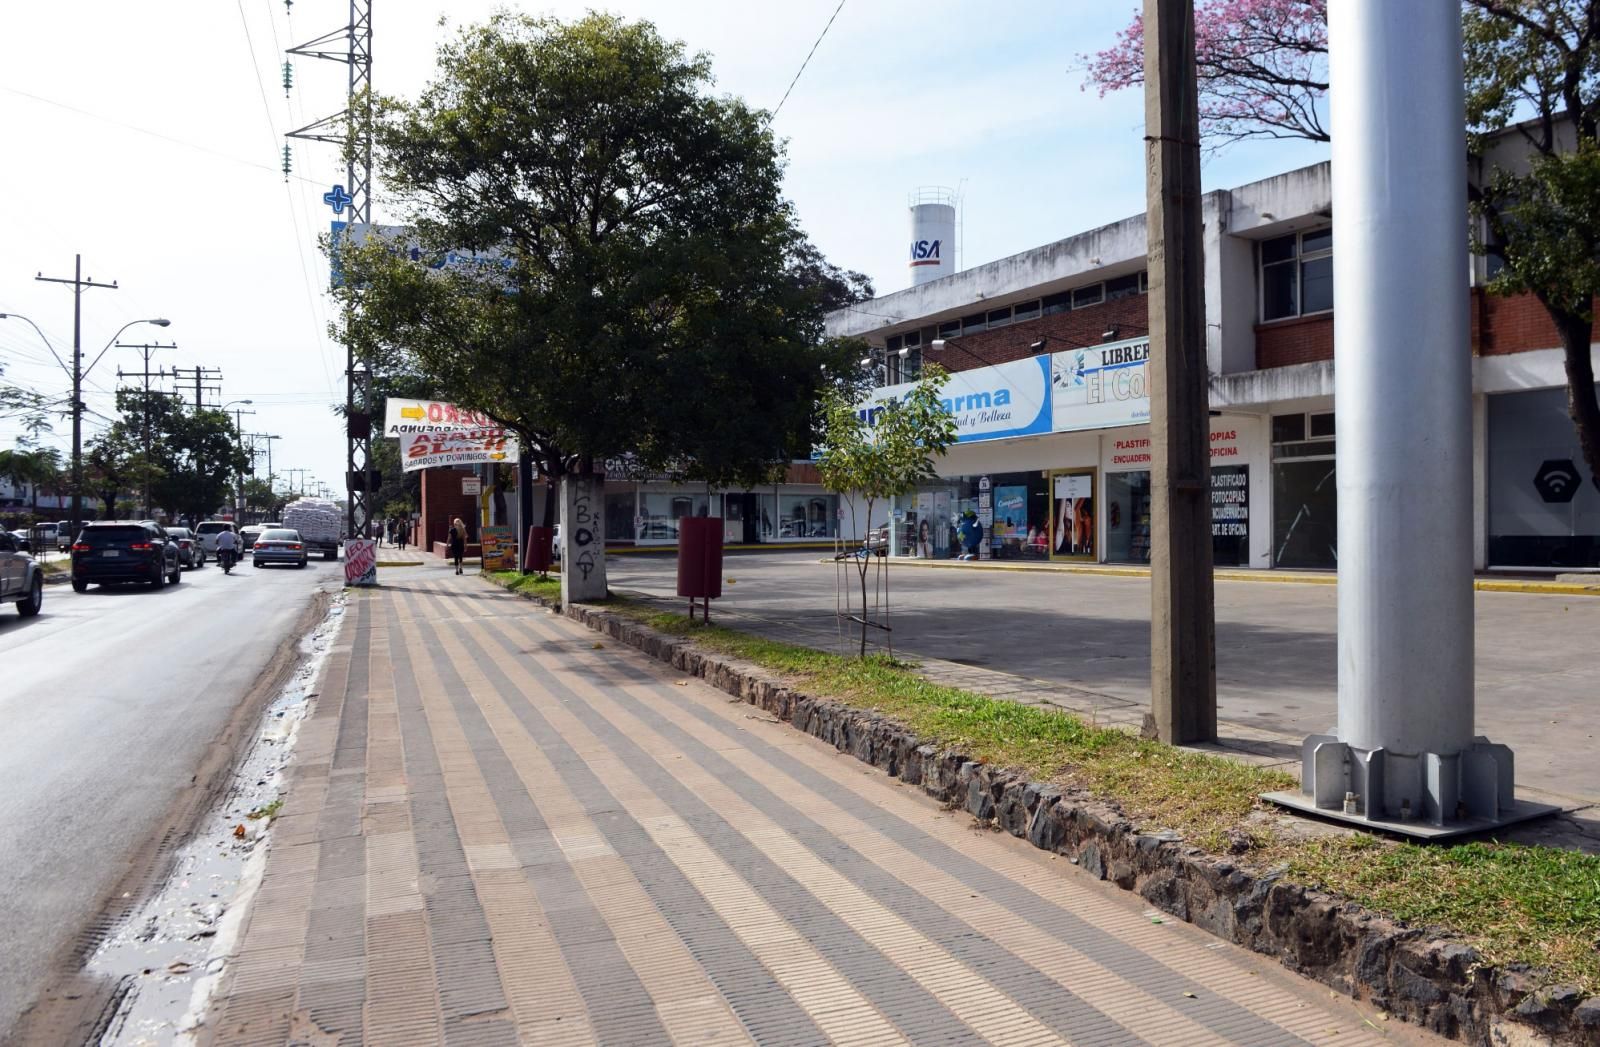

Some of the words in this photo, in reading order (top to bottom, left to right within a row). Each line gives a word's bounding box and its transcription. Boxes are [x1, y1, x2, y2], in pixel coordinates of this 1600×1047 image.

[1087, 369, 1105, 404] El
[978, 408, 1011, 423] Belleza
[1209, 431, 1236, 441] OPIAS
[1116, 439, 1150, 449] PLASTIFI
[446, 453, 487, 462] DOMINGOS
[1211, 474, 1246, 487] PLASTIFICADO
[1211, 490, 1246, 503] FOTOCOPIAS
[1212, 507, 1248, 519] NCUADERNACION
[1221, 524, 1228, 536] DE
[1229, 523, 1247, 535] OFICINA
